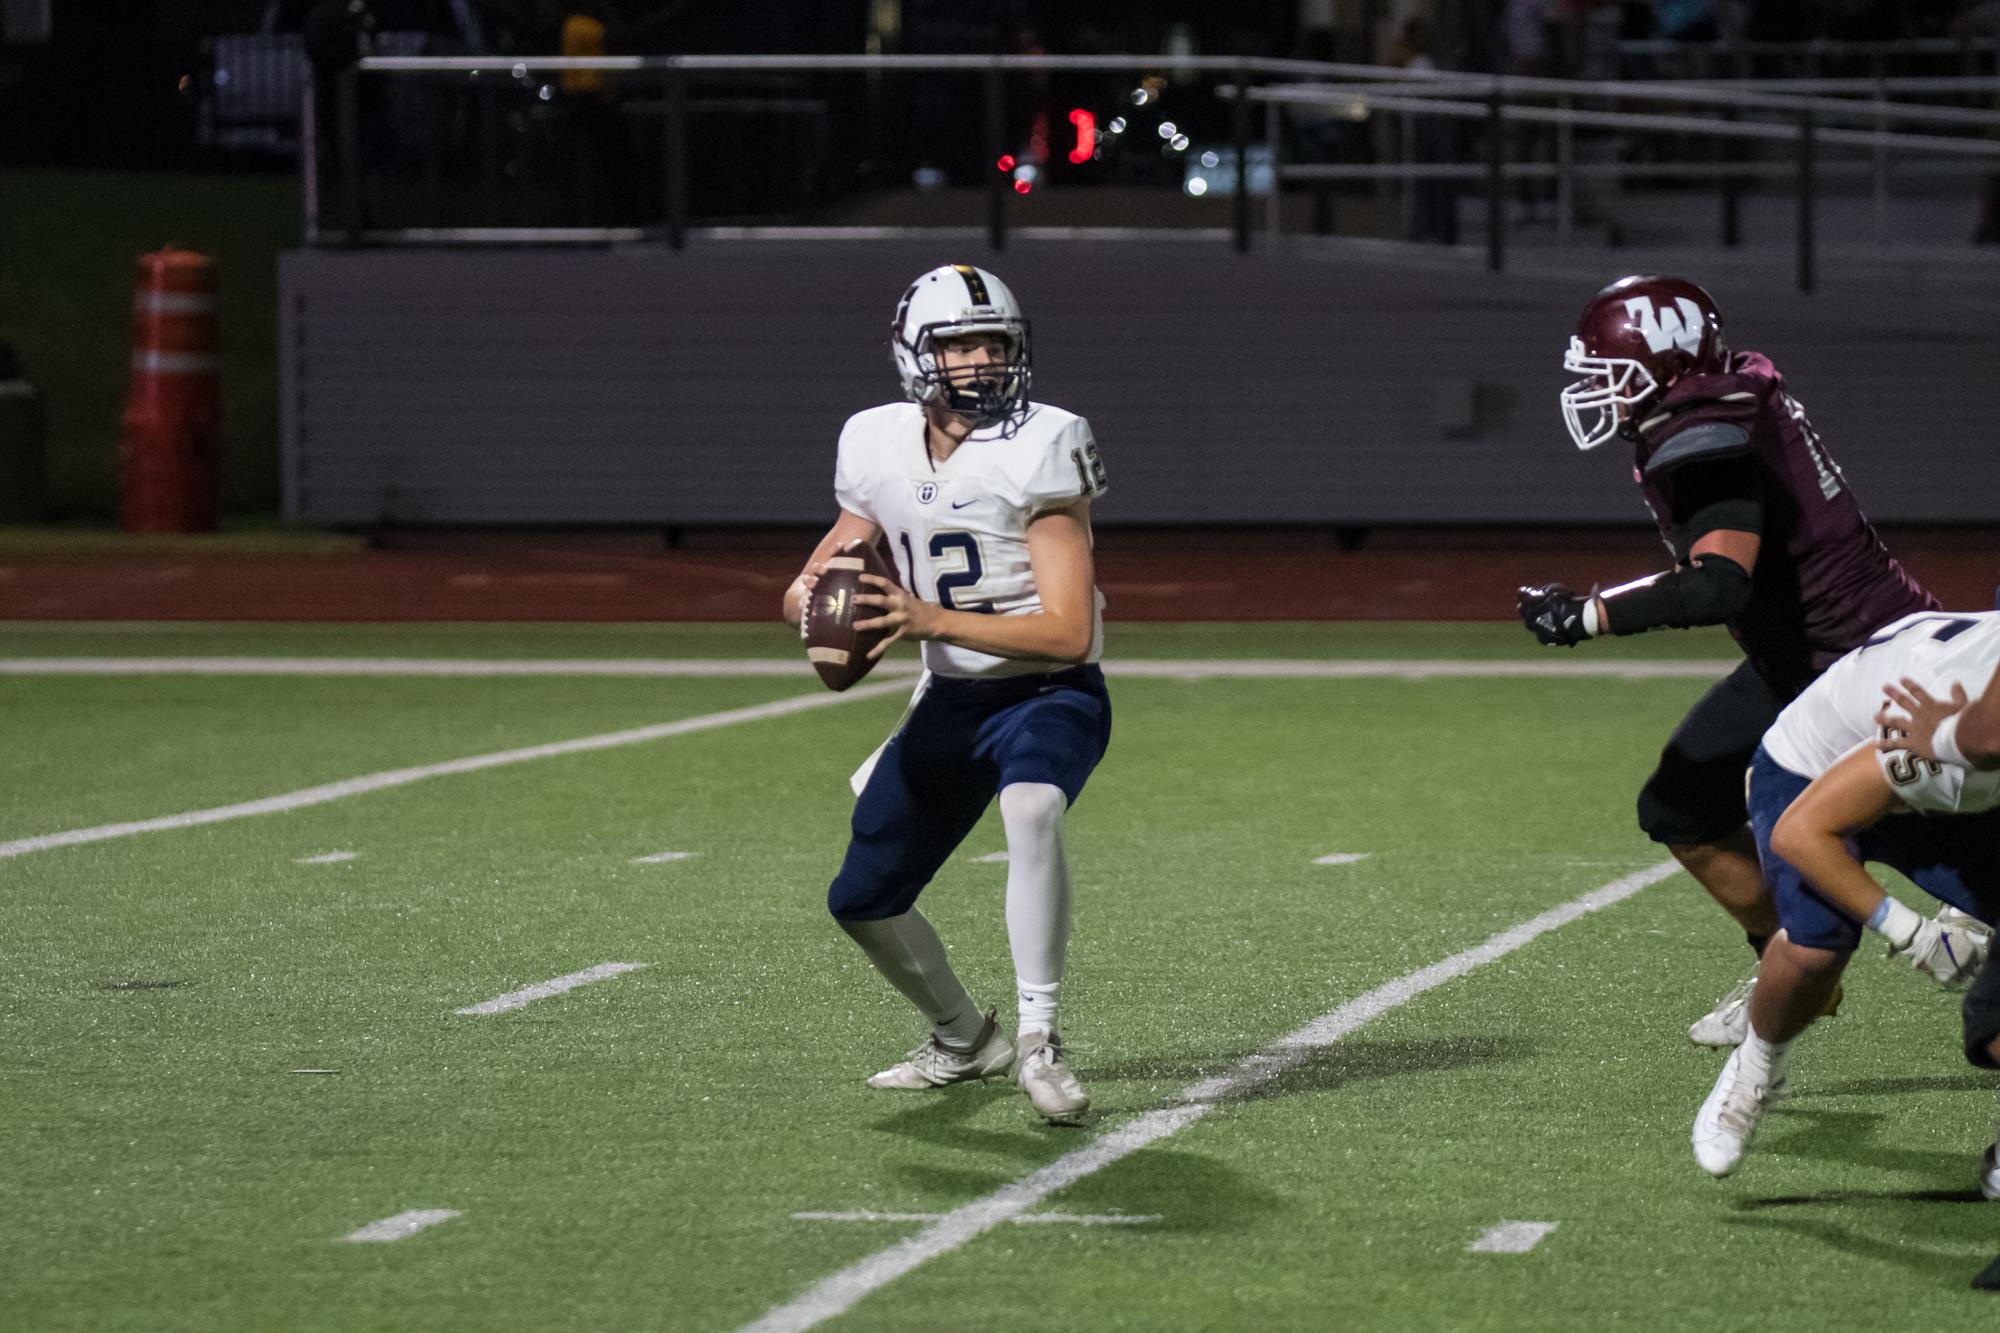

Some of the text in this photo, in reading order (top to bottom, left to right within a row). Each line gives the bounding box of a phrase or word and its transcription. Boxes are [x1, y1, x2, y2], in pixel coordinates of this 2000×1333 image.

[1624, 295, 1704, 357] W
[1070, 440, 1108, 496] 12
[899, 527, 992, 614] 12
